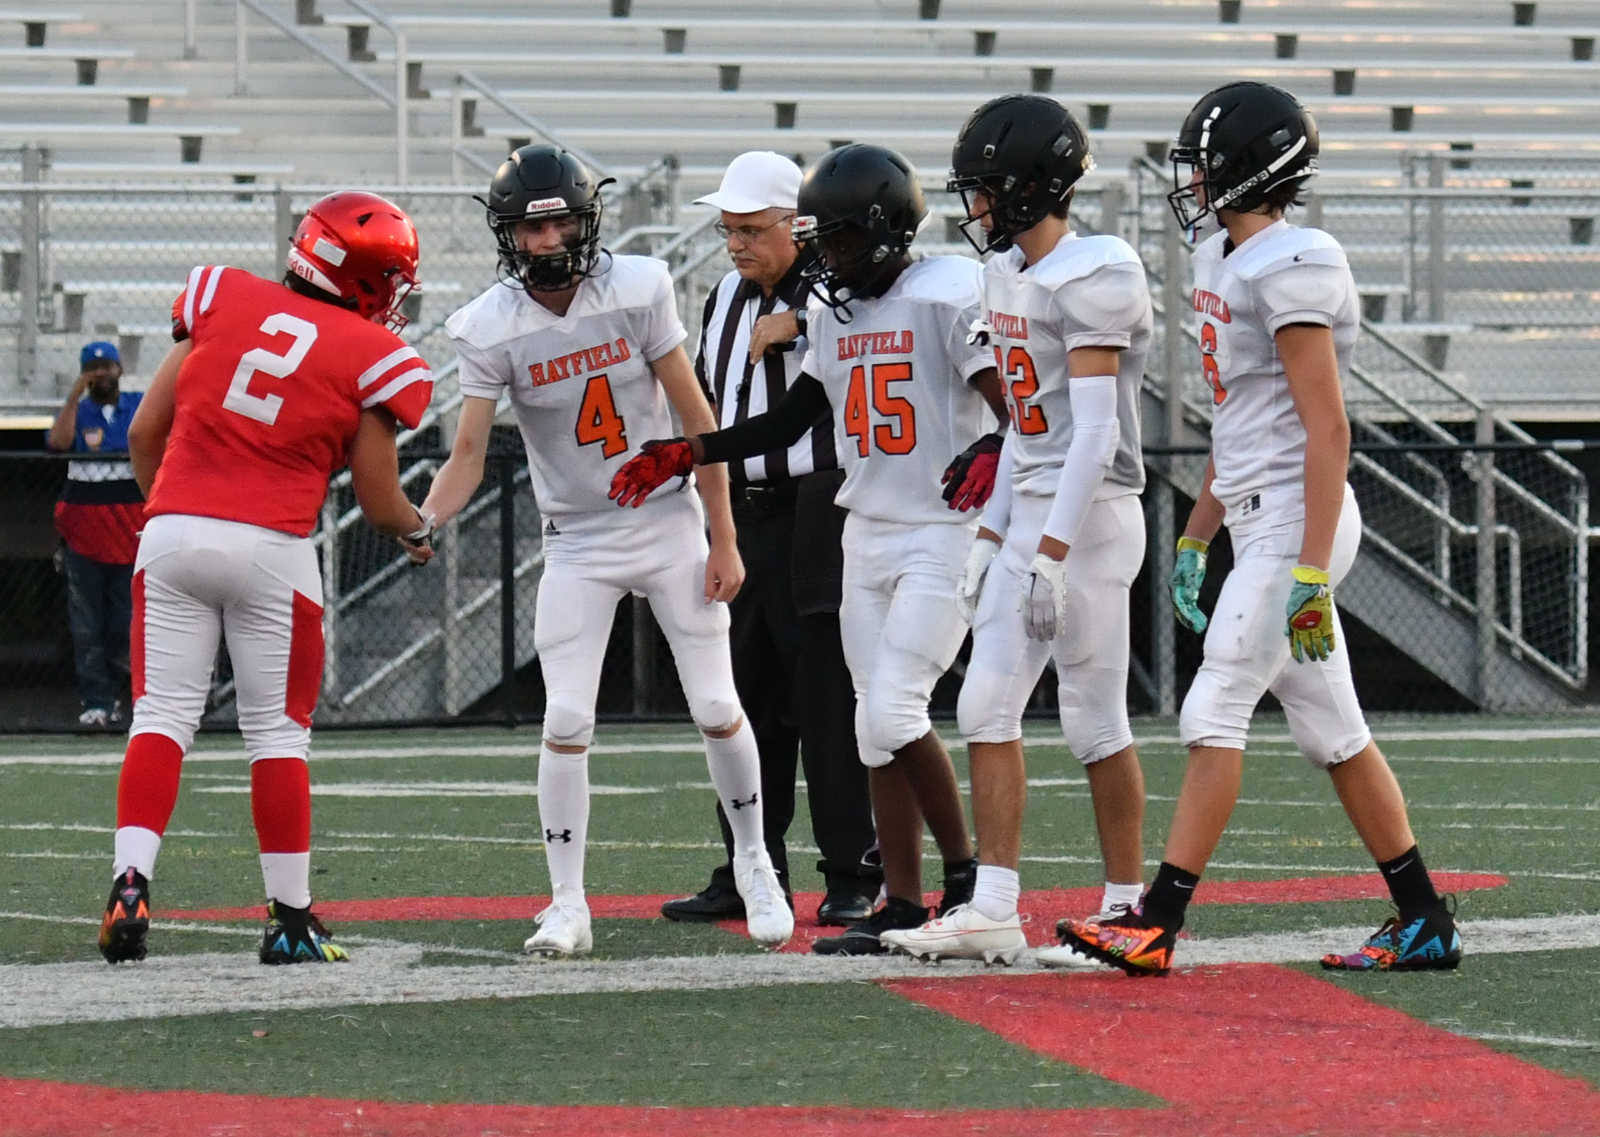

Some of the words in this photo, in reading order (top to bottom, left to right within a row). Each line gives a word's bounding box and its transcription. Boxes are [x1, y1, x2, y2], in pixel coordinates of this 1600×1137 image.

[531, 200, 562, 210] Riddell
[1222, 171, 1268, 205] ARMOUR
[837, 330, 914, 361] HAYFIELD
[988, 310, 1028, 340] AYFIELD
[222, 312, 319, 426] 2
[528, 337, 631, 388] HAYFIELD
[574, 373, 629, 461] 4
[844, 362, 917, 458] 45
